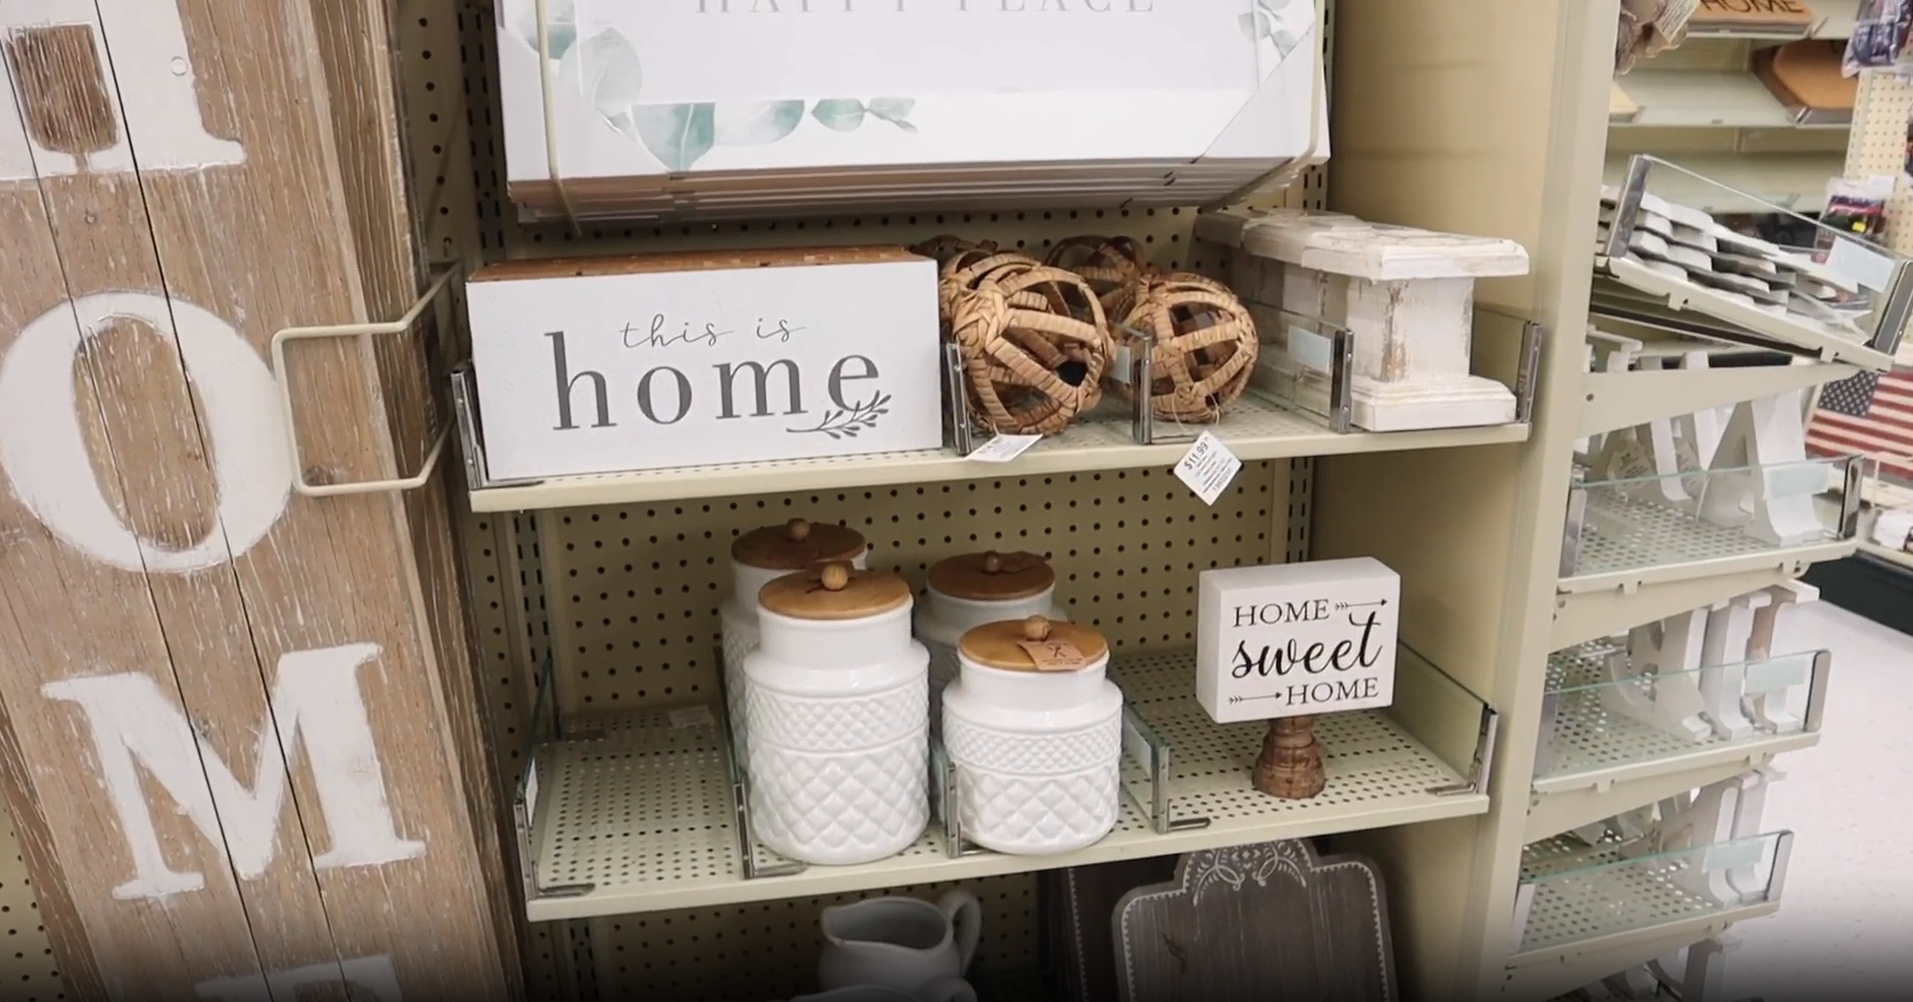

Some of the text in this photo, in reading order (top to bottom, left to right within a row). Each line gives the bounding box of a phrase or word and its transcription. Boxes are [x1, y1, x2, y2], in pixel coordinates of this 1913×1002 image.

[621, 313, 807, 348] this is
[544, 330, 881, 432] home
[1233, 598, 1330, 628] HOME
[1231, 610, 1383, 679] sweet
[1285, 676, 1379, 707] HOME
